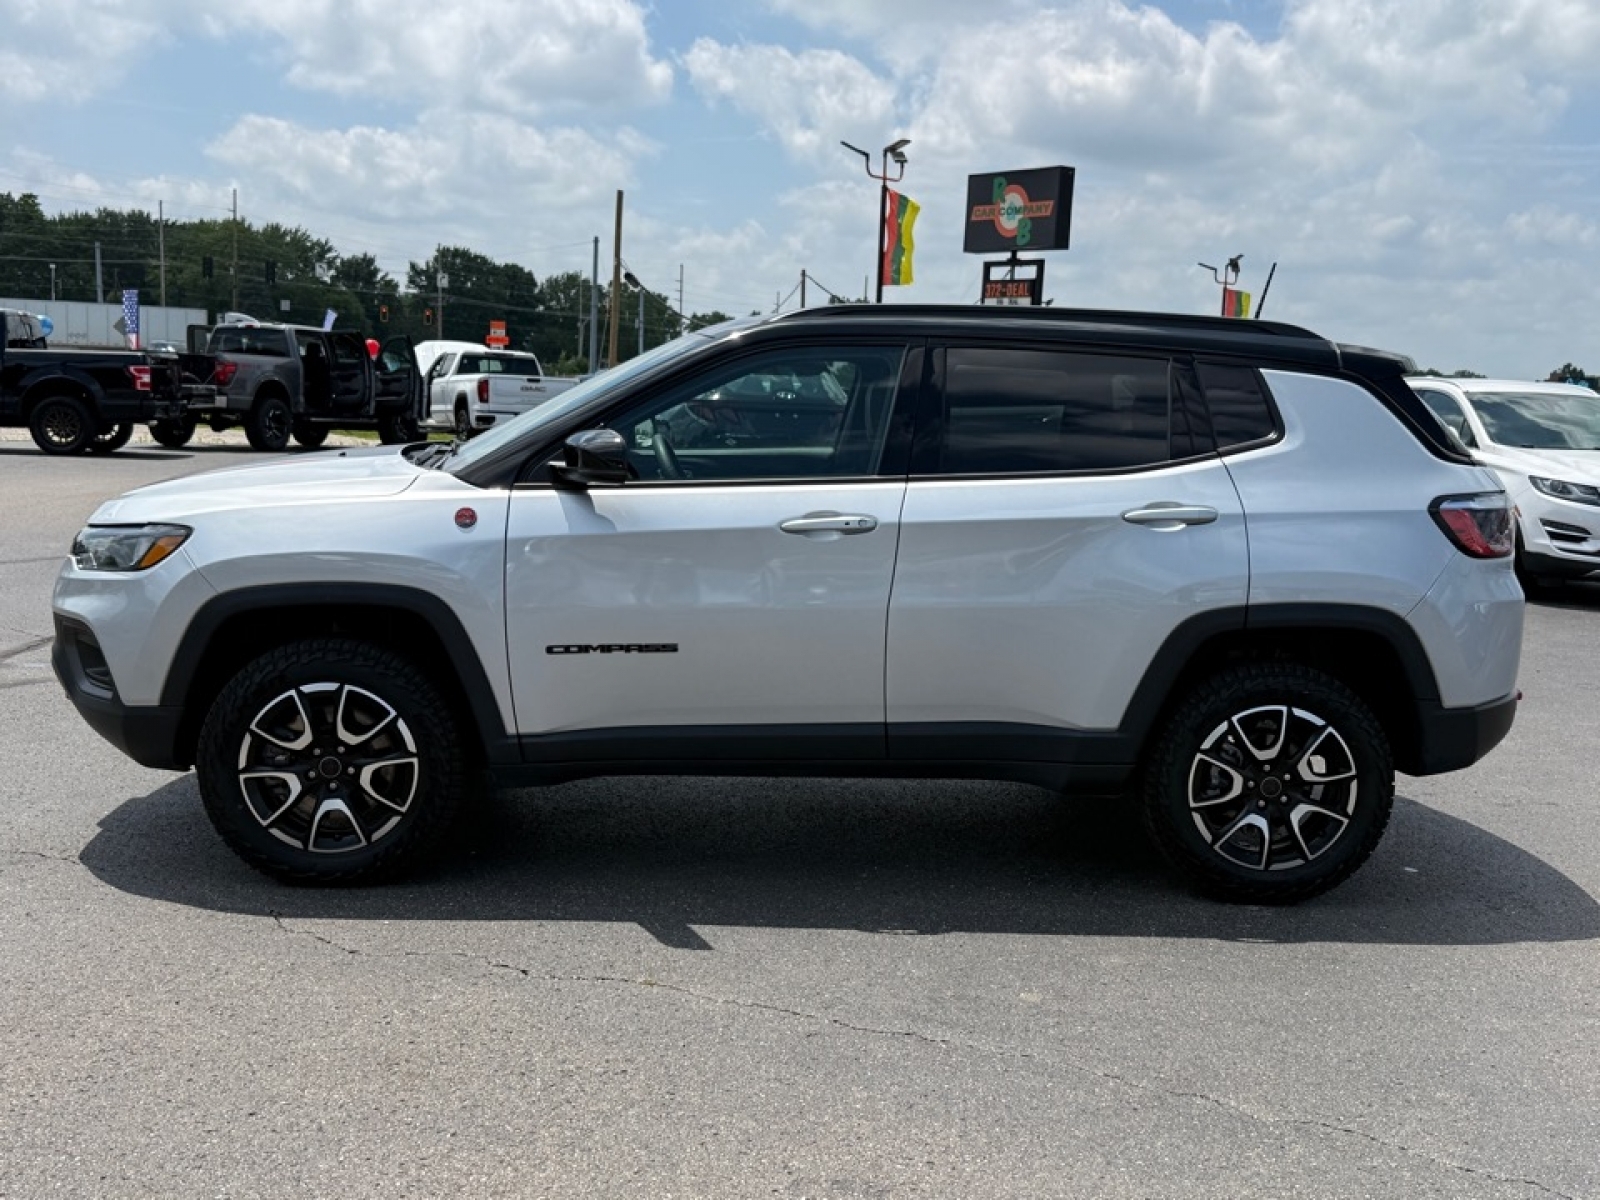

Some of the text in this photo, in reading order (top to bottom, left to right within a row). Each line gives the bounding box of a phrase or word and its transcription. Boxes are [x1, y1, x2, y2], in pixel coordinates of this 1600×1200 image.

[974, 203, 1051, 218] CAR COMPANY
[545, 643, 679, 654] COMPASS
